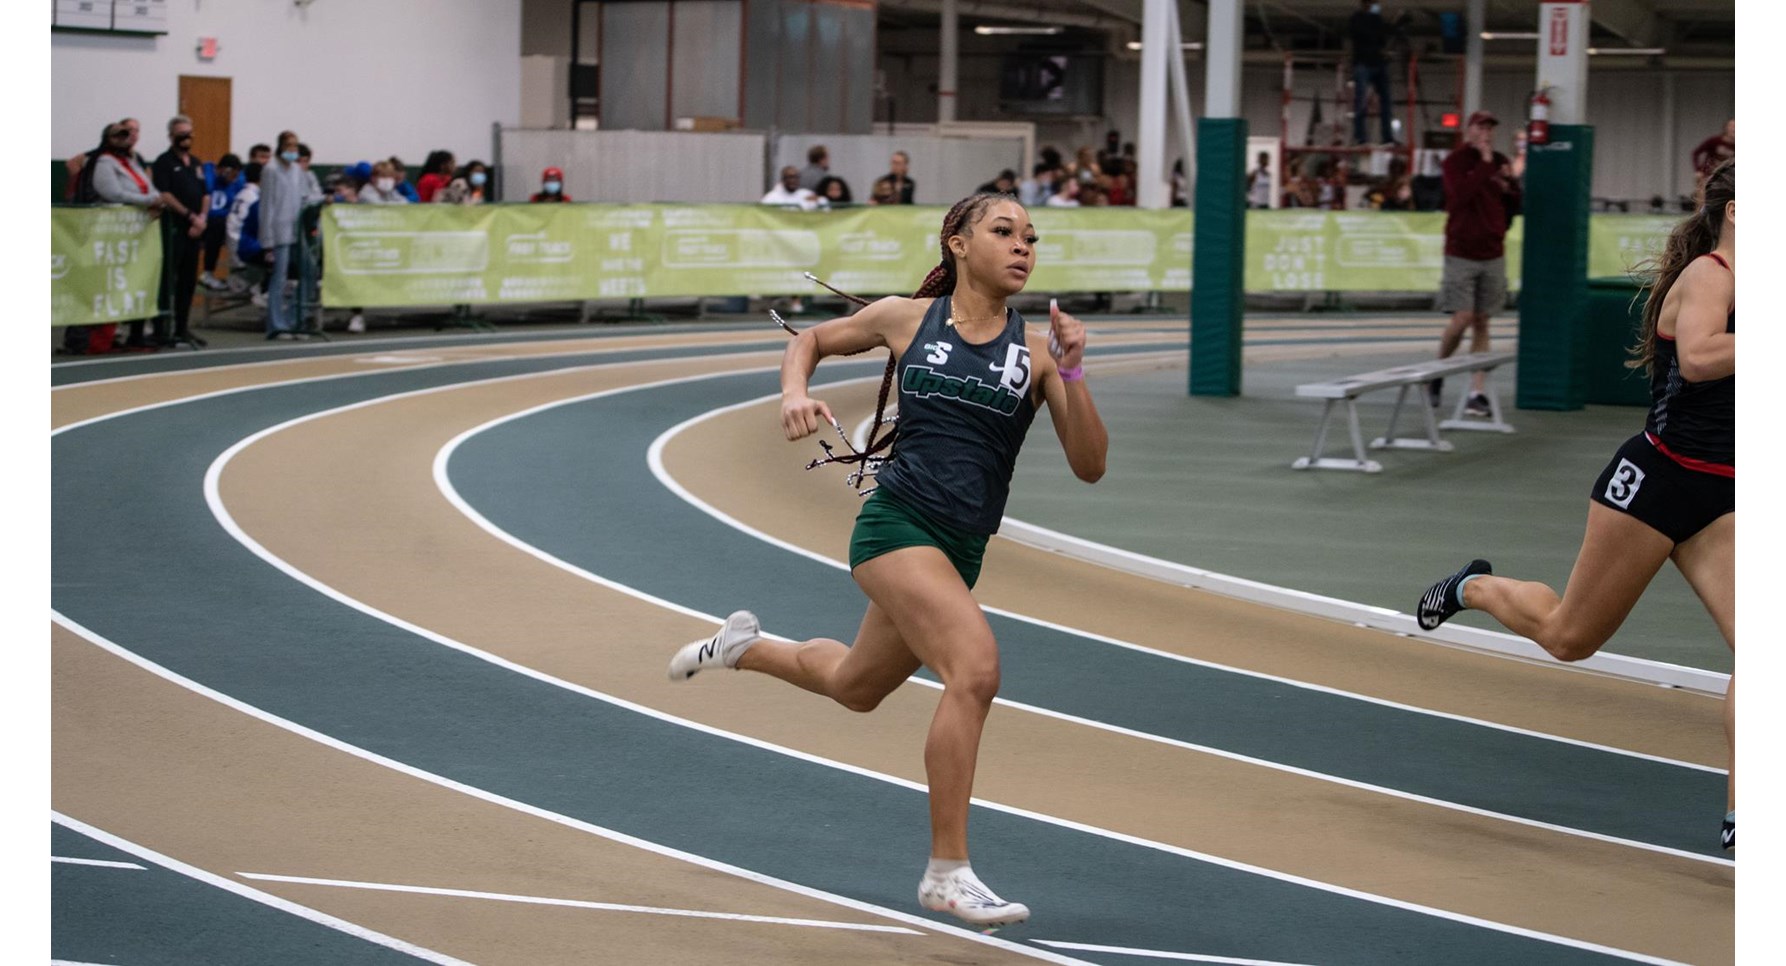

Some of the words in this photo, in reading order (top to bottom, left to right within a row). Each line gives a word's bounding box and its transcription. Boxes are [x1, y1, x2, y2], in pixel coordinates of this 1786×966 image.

[94, 241, 139, 264] FAST
[1276, 235, 1325, 252] JUST
[107, 267, 128, 290] IS
[1272, 272, 1324, 289] LOSE
[94, 290, 148, 318] FLAT
[1009, 348, 1031, 390] 5
[902, 365, 1021, 416] Upstate
[1611, 465, 1637, 501] 3
